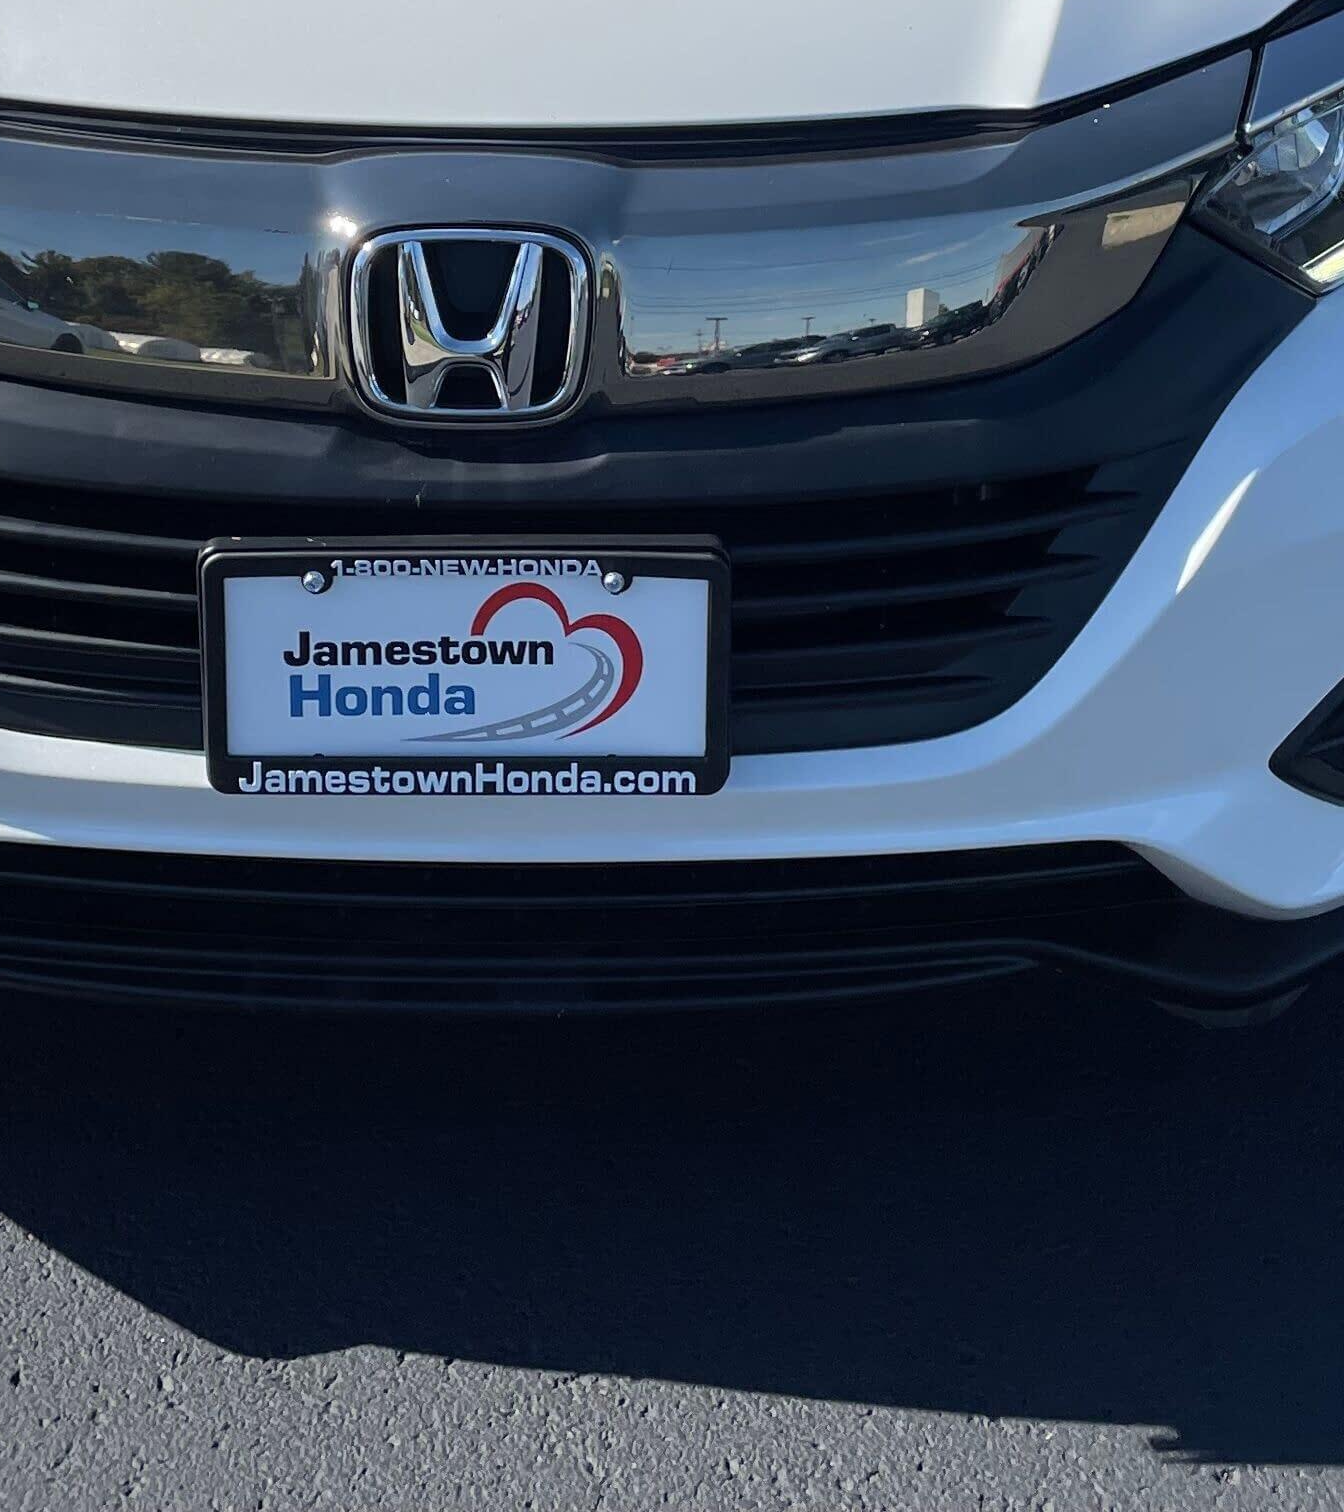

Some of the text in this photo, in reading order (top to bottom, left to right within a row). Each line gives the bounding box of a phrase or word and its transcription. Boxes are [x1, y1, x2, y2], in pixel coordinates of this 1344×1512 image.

[330, 559, 603, 577] 1-800-NEW-HONDA
[283, 631, 555, 667] Jamestown
[288, 673, 477, 718] Honda
[238, 761, 697, 794] JamestownHonda.com
